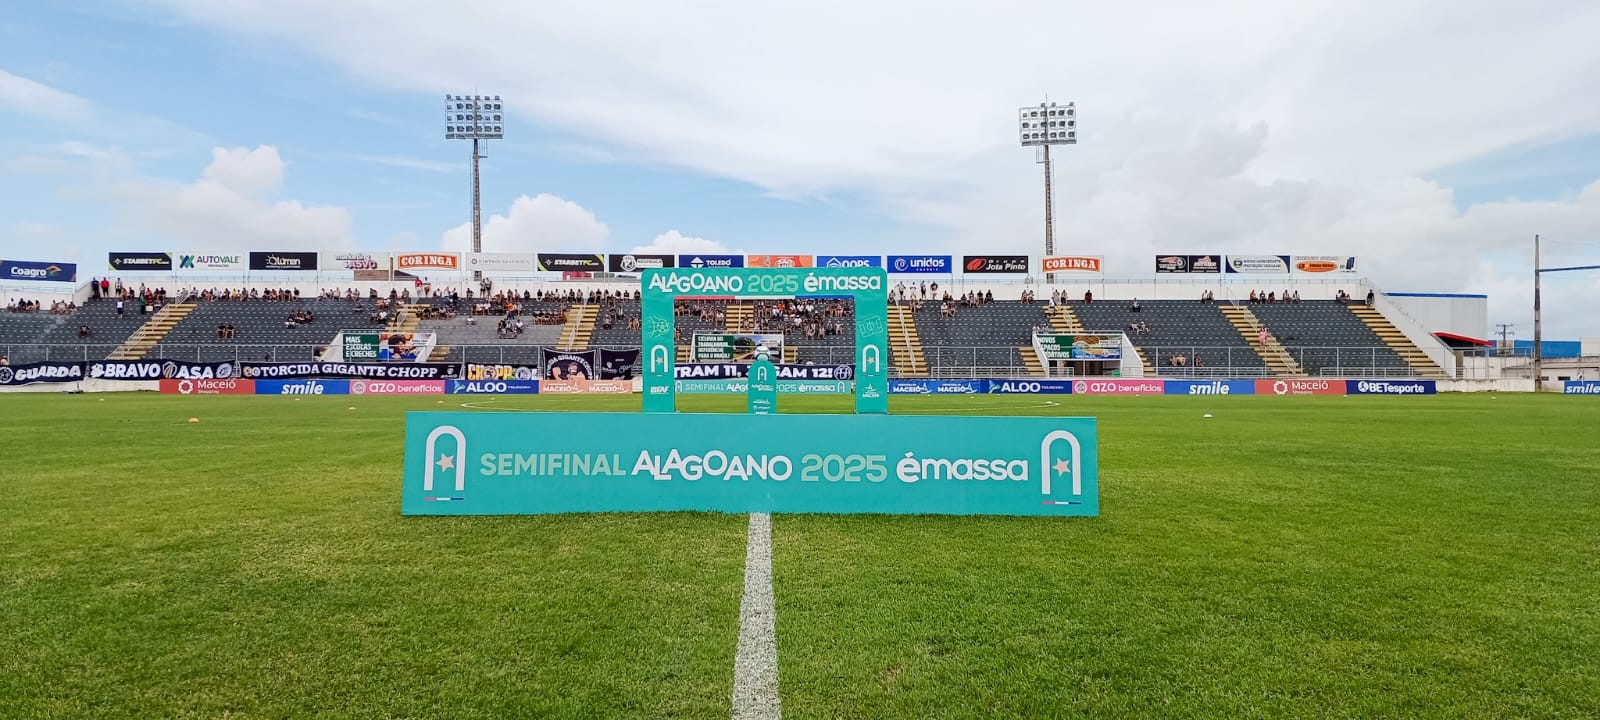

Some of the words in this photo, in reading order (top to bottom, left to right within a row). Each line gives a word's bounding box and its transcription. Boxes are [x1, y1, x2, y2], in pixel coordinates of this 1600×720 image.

[401, 255, 454, 266] CORINGA
[910, 258, 944, 268] unidos
[1046, 258, 1096, 269] CORINGA
[11, 266, 46, 277] Coagro
[648, 272, 744, 293] ALAGOANO
[748, 274, 798, 293] 2025
[804, 272, 880, 292] émassa
[15, 366, 81, 380] GUARDA
[104, 363, 160, 378] BRAVO
[175, 365, 214, 379] ASA
[260, 364, 323, 376] TORCIDA
[322, 364, 386, 378] GIGANTE
[388, 366, 438, 378] CHOPP
[812, 367, 832, 378] 12!
[198, 380, 236, 390] Maceió
[281, 381, 324, 394] smile
[369, 383, 396, 393] azo
[466, 382, 506, 393] ALOO
[1002, 382, 1040, 392] ALOO
[1090, 382, 1116, 392] azo
[1189, 382, 1230, 394] smile
[1292, 381, 1328, 390] Maceió
[1368, 382, 1424, 394] BETesporte
[1566, 383, 1600, 394] smile
[480, 453, 626, 476] SEMIFINAL
[631, 448, 792, 481] ALAGOANO
[800, 453, 888, 482] 2025
[896, 452, 1028, 483] émassa
